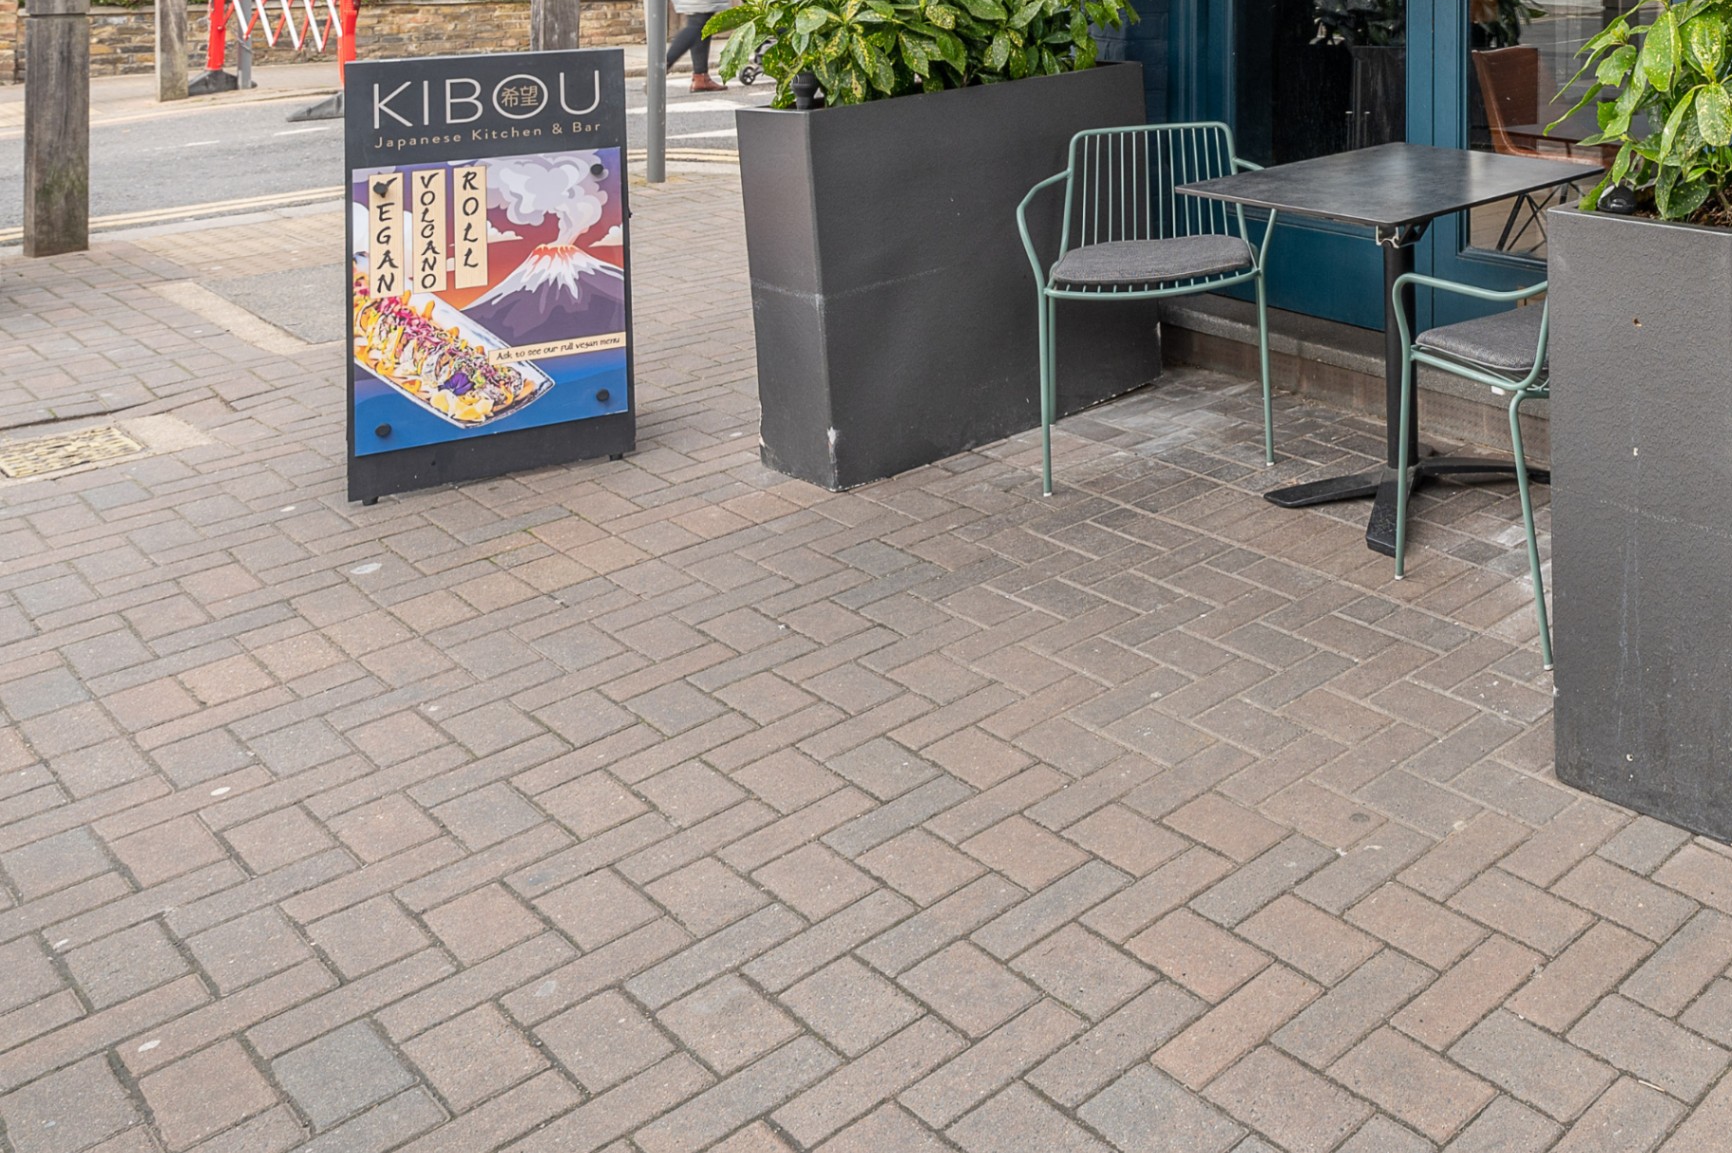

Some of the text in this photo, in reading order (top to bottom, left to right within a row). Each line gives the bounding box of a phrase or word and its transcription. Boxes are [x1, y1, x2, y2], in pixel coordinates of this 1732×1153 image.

[373, 69, 600, 130] KIBOU
[501, 85, 540, 108] 希望
[374, 121, 601, 150] Japanese Kitchen & Bar
[420, 171, 441, 290] VOLCANO
[462, 170, 480, 268] ROLL
[496, 351, 512, 361] Ask
[515, 350, 526, 359] to
[528, 347, 541, 356] see
[543, 346, 558, 354] our
[576, 339, 599, 349] vegan
[600, 337, 620, 346] menu
